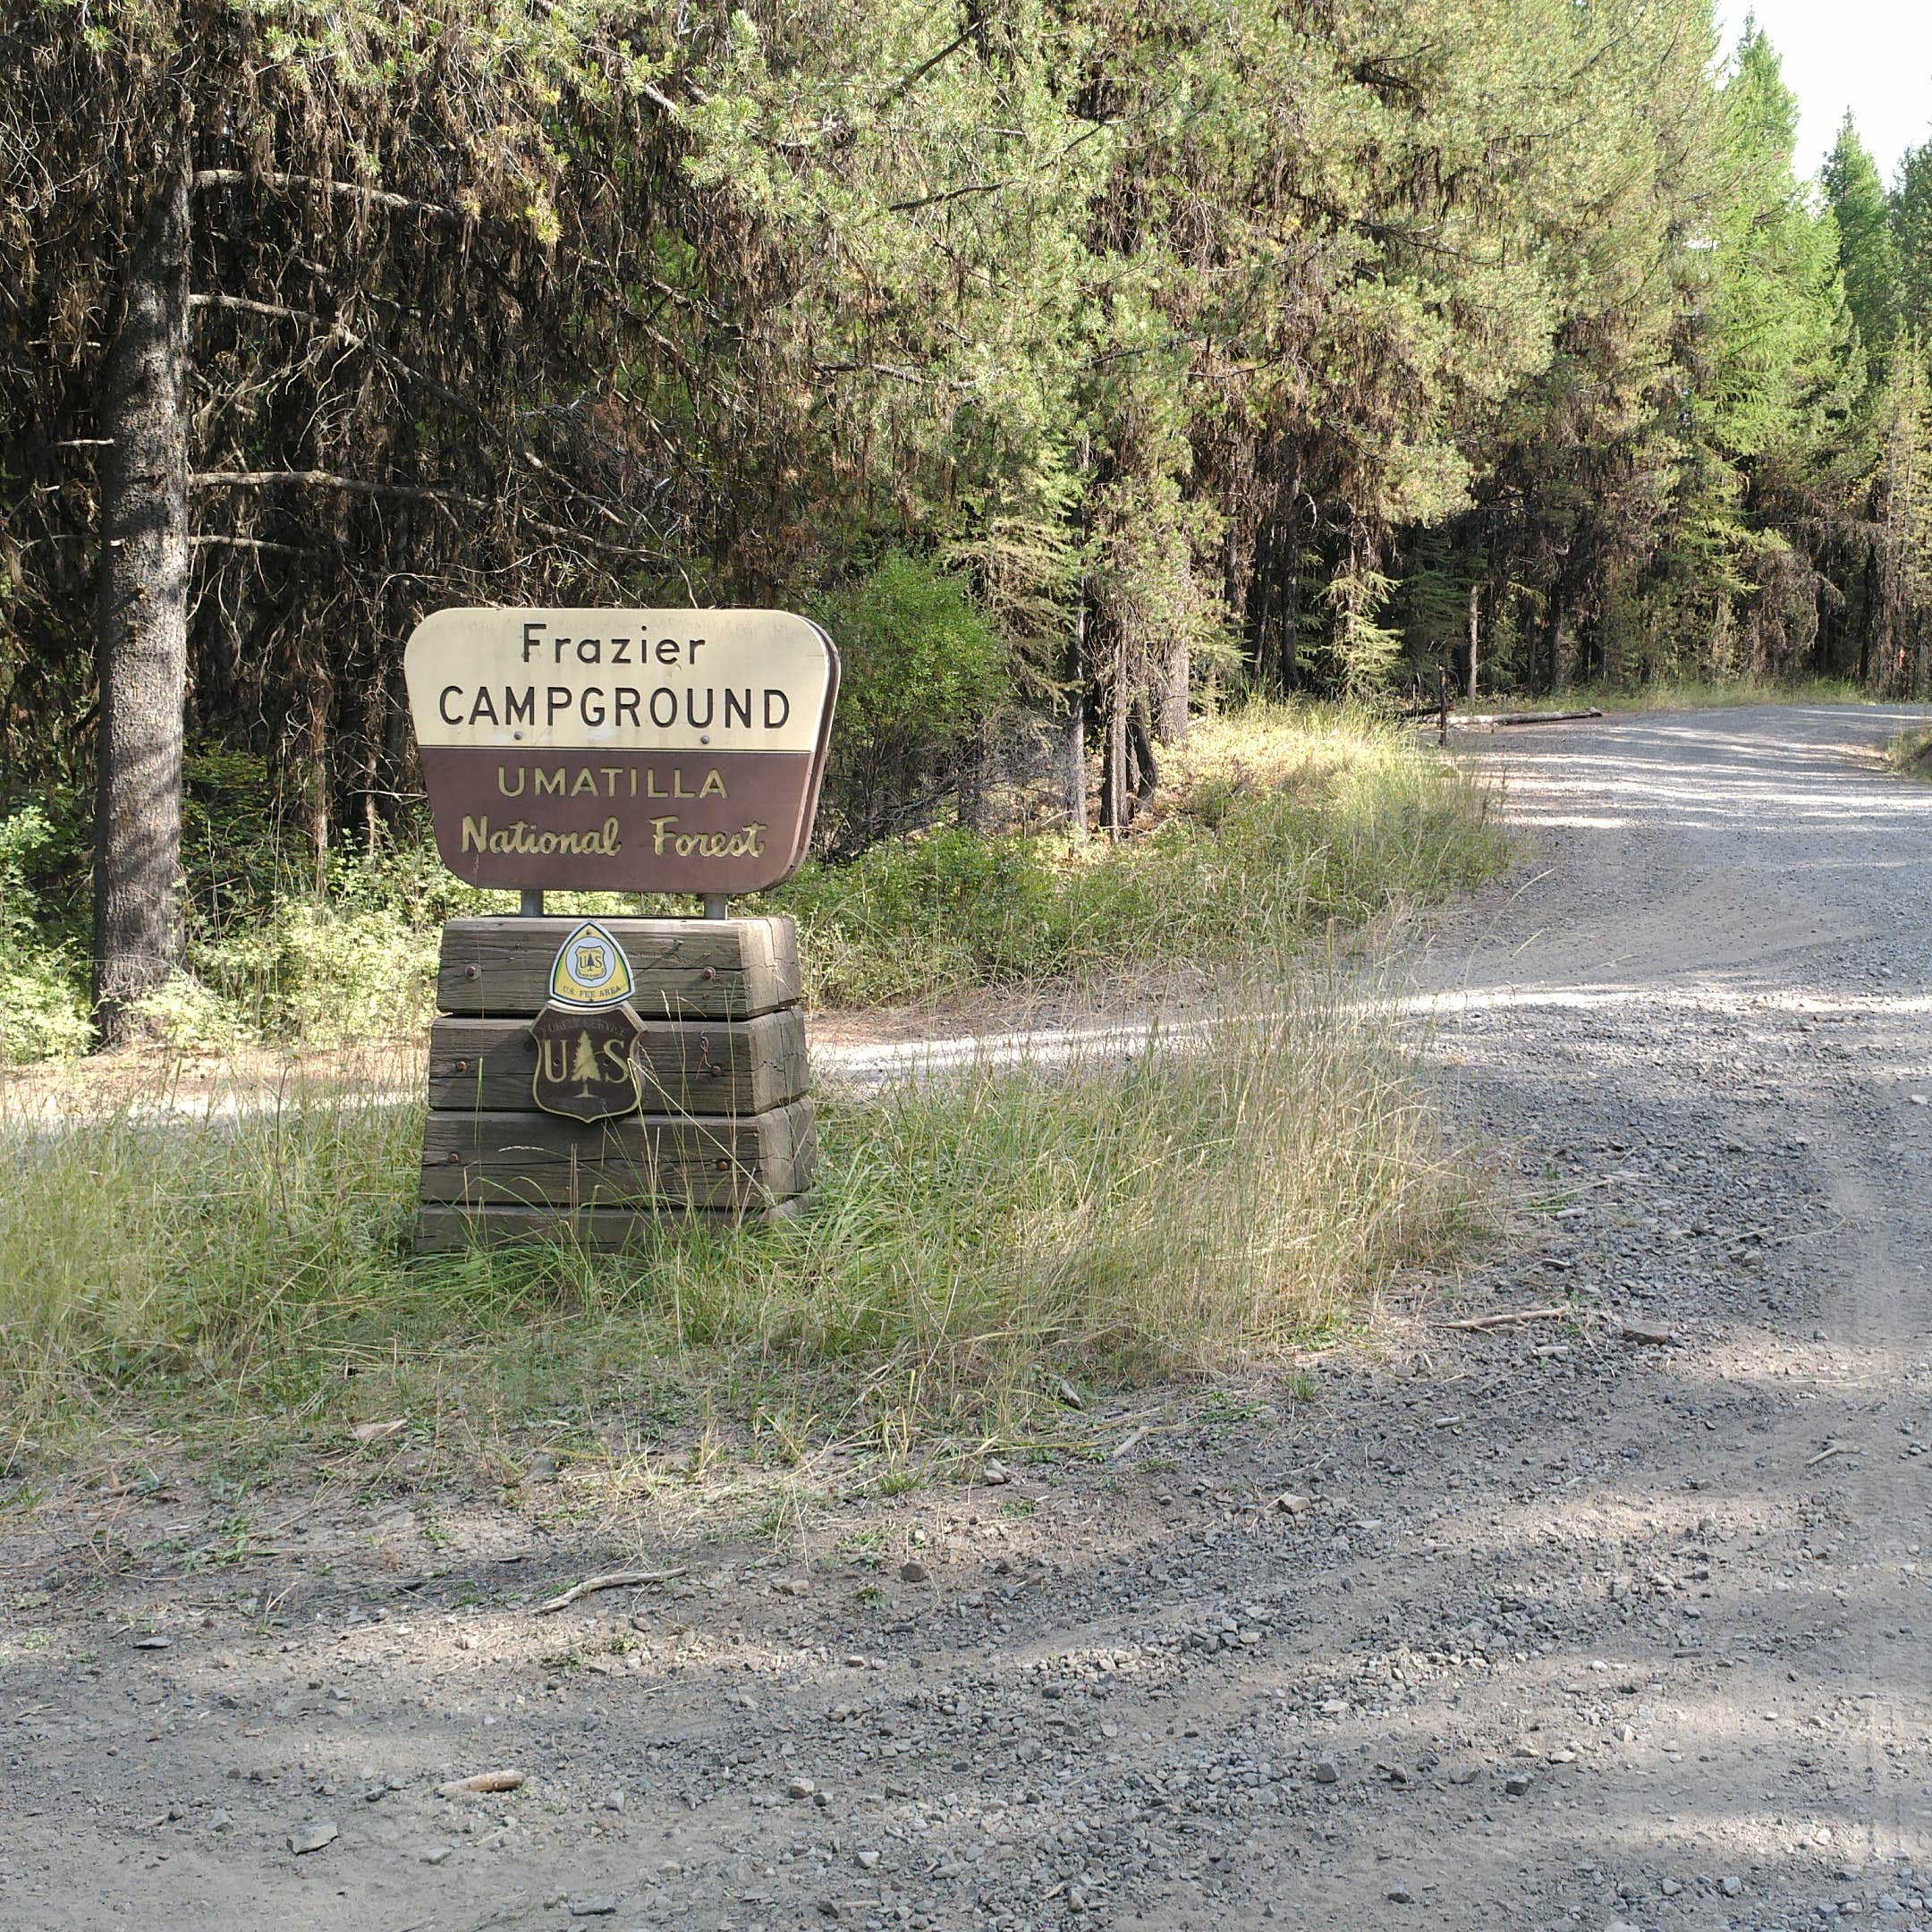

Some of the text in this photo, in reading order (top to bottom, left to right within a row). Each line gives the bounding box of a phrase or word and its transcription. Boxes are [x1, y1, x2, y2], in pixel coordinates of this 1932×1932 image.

[523, 623, 706, 665] Frazier
[439, 685, 790, 729] CAMPGROUND
[497, 765, 730, 799] UMATILLA
[461, 813, 767, 857] National Forest
[580, 989, 597, 998] FEE
[599, 985, 622, 997] AREA
